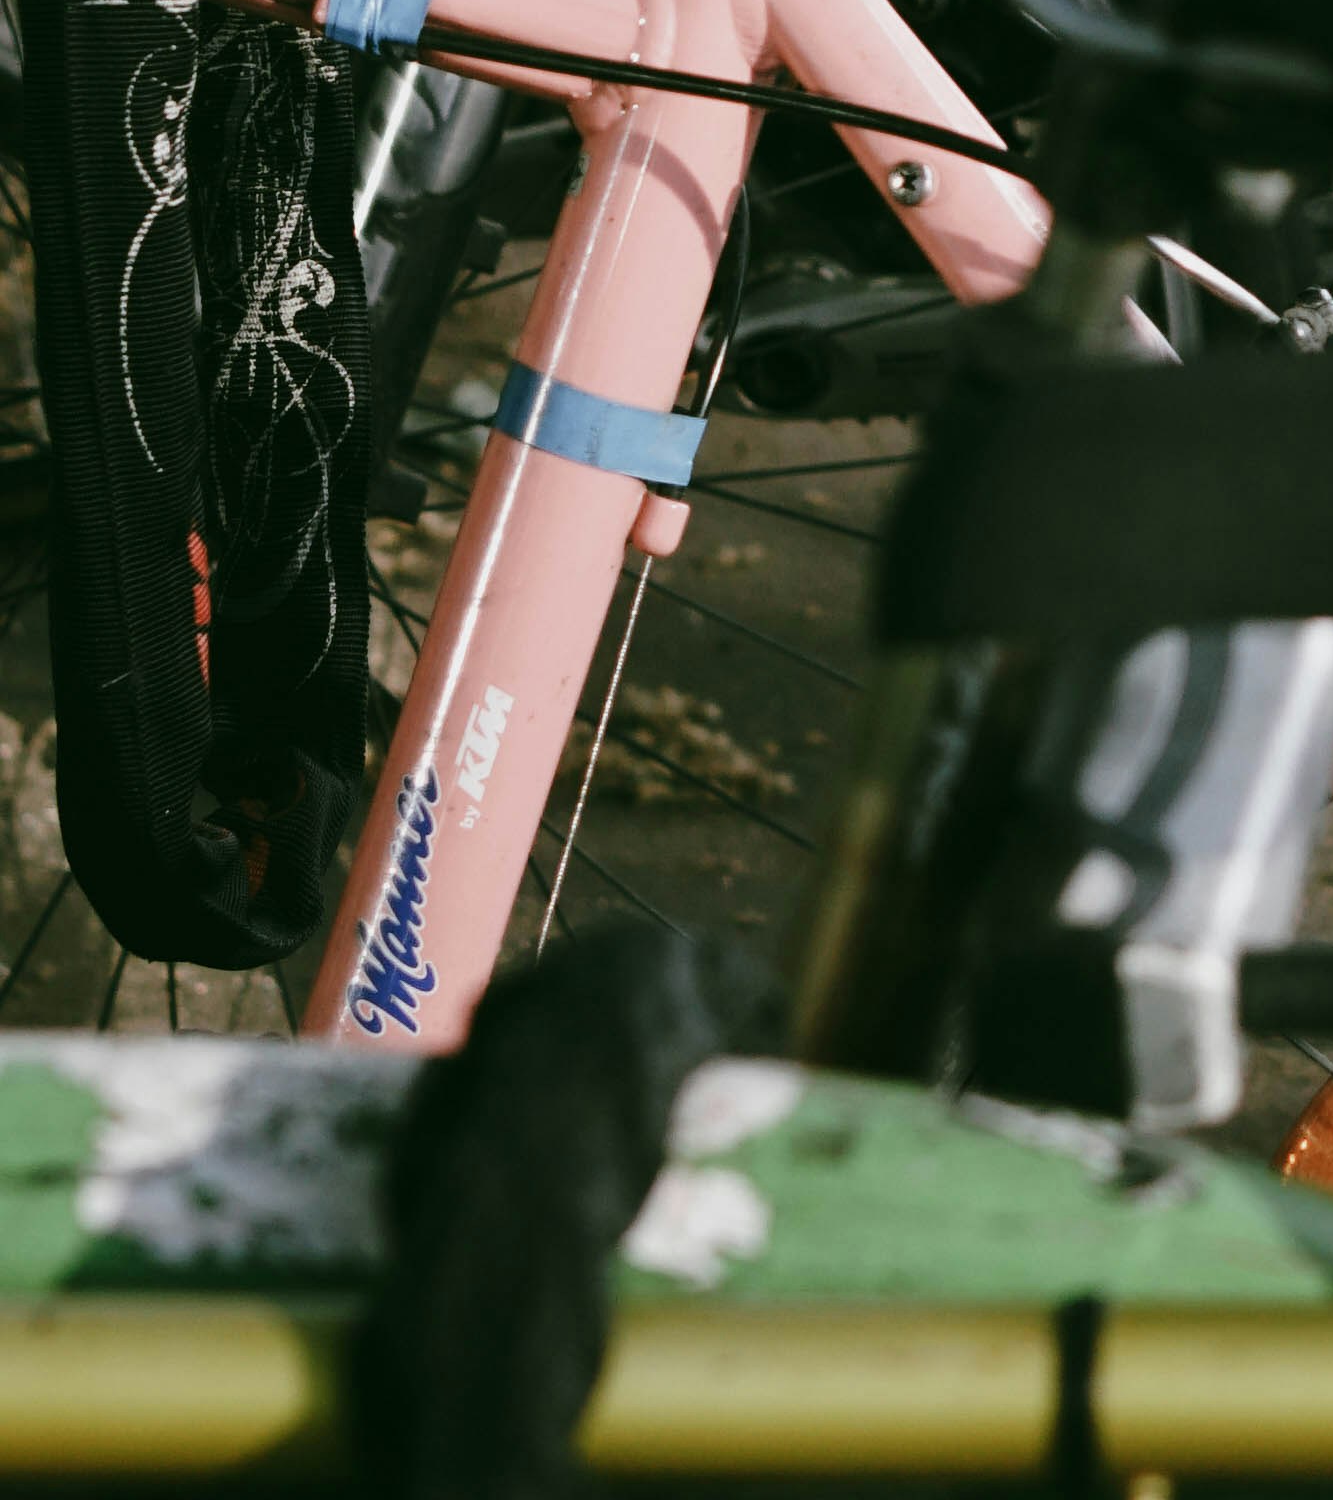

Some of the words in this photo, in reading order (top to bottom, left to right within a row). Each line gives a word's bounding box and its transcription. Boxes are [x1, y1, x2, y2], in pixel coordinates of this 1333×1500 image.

[454, 684, 517, 801] KTM
[459, 805, 482, 831] by
[346, 763, 441, 1038] Manner
